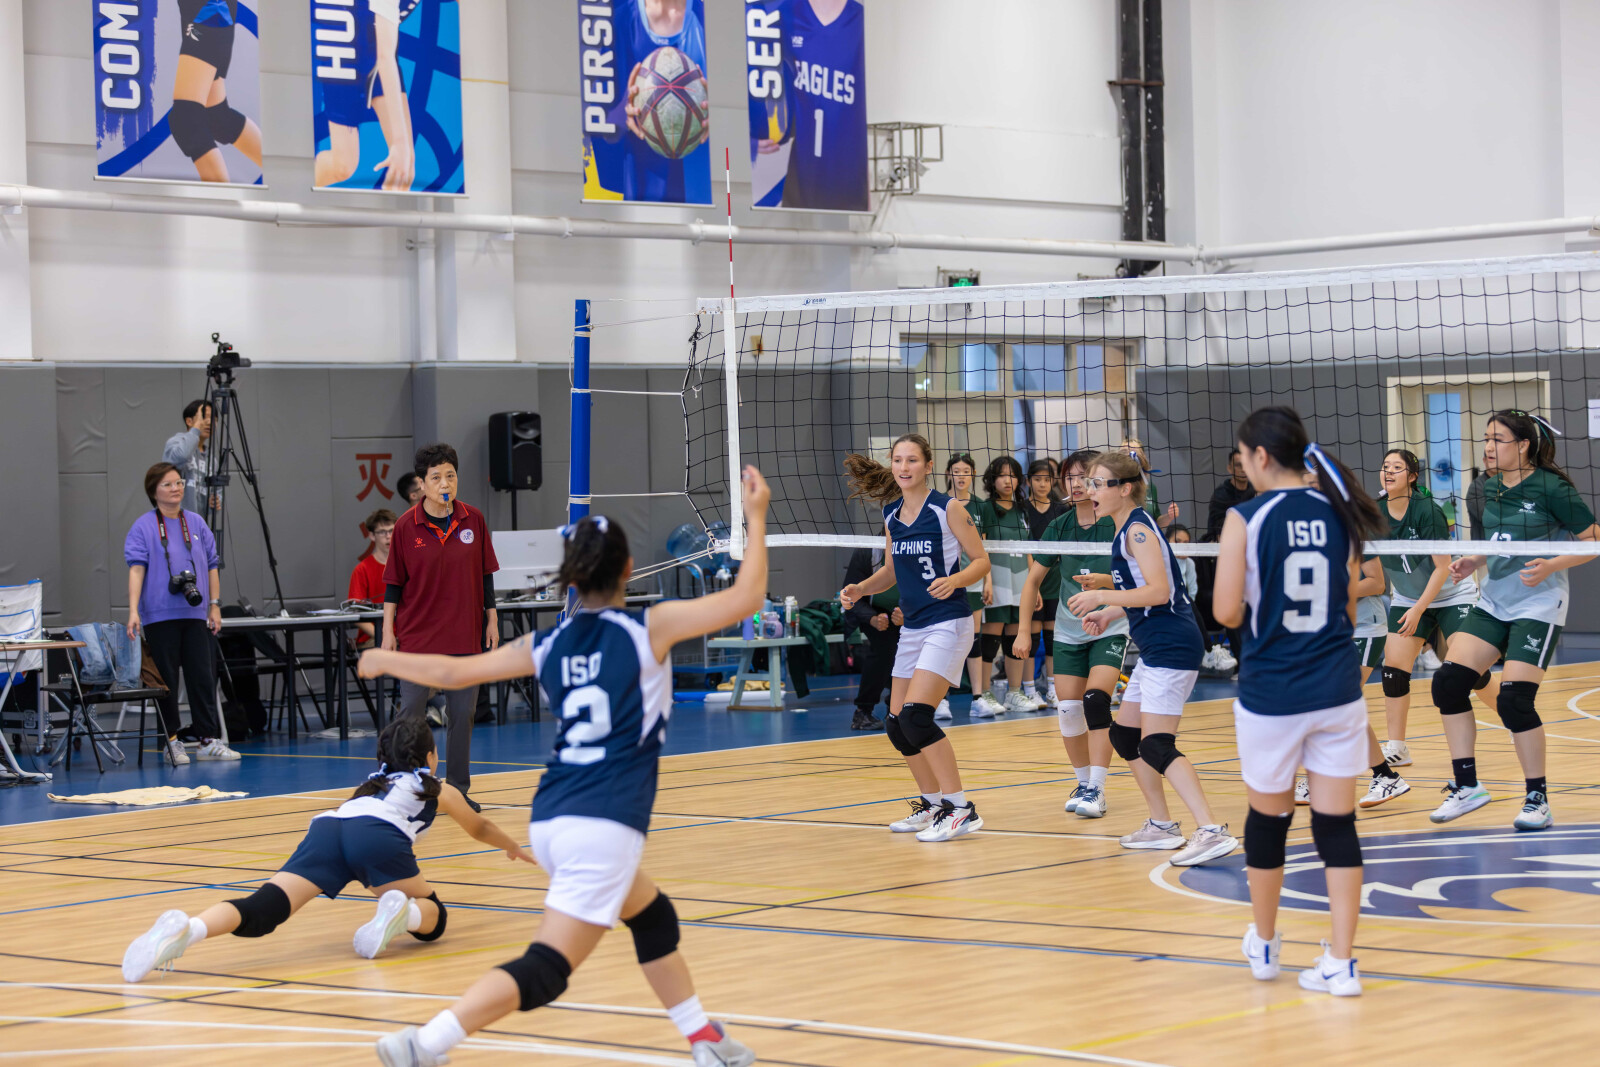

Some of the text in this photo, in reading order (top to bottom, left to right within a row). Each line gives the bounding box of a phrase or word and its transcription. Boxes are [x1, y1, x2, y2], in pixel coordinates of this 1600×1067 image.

[581, 0, 616, 133] PERSI
[746, 0, 783, 99] SER
[814, 109, 824, 157] 1
[1286, 519, 1328, 547] ISO
[918, 556, 936, 580] 3
[1282, 551, 1329, 634] 9
[561, 651, 602, 688] ISO
[559, 684, 612, 766] 2
